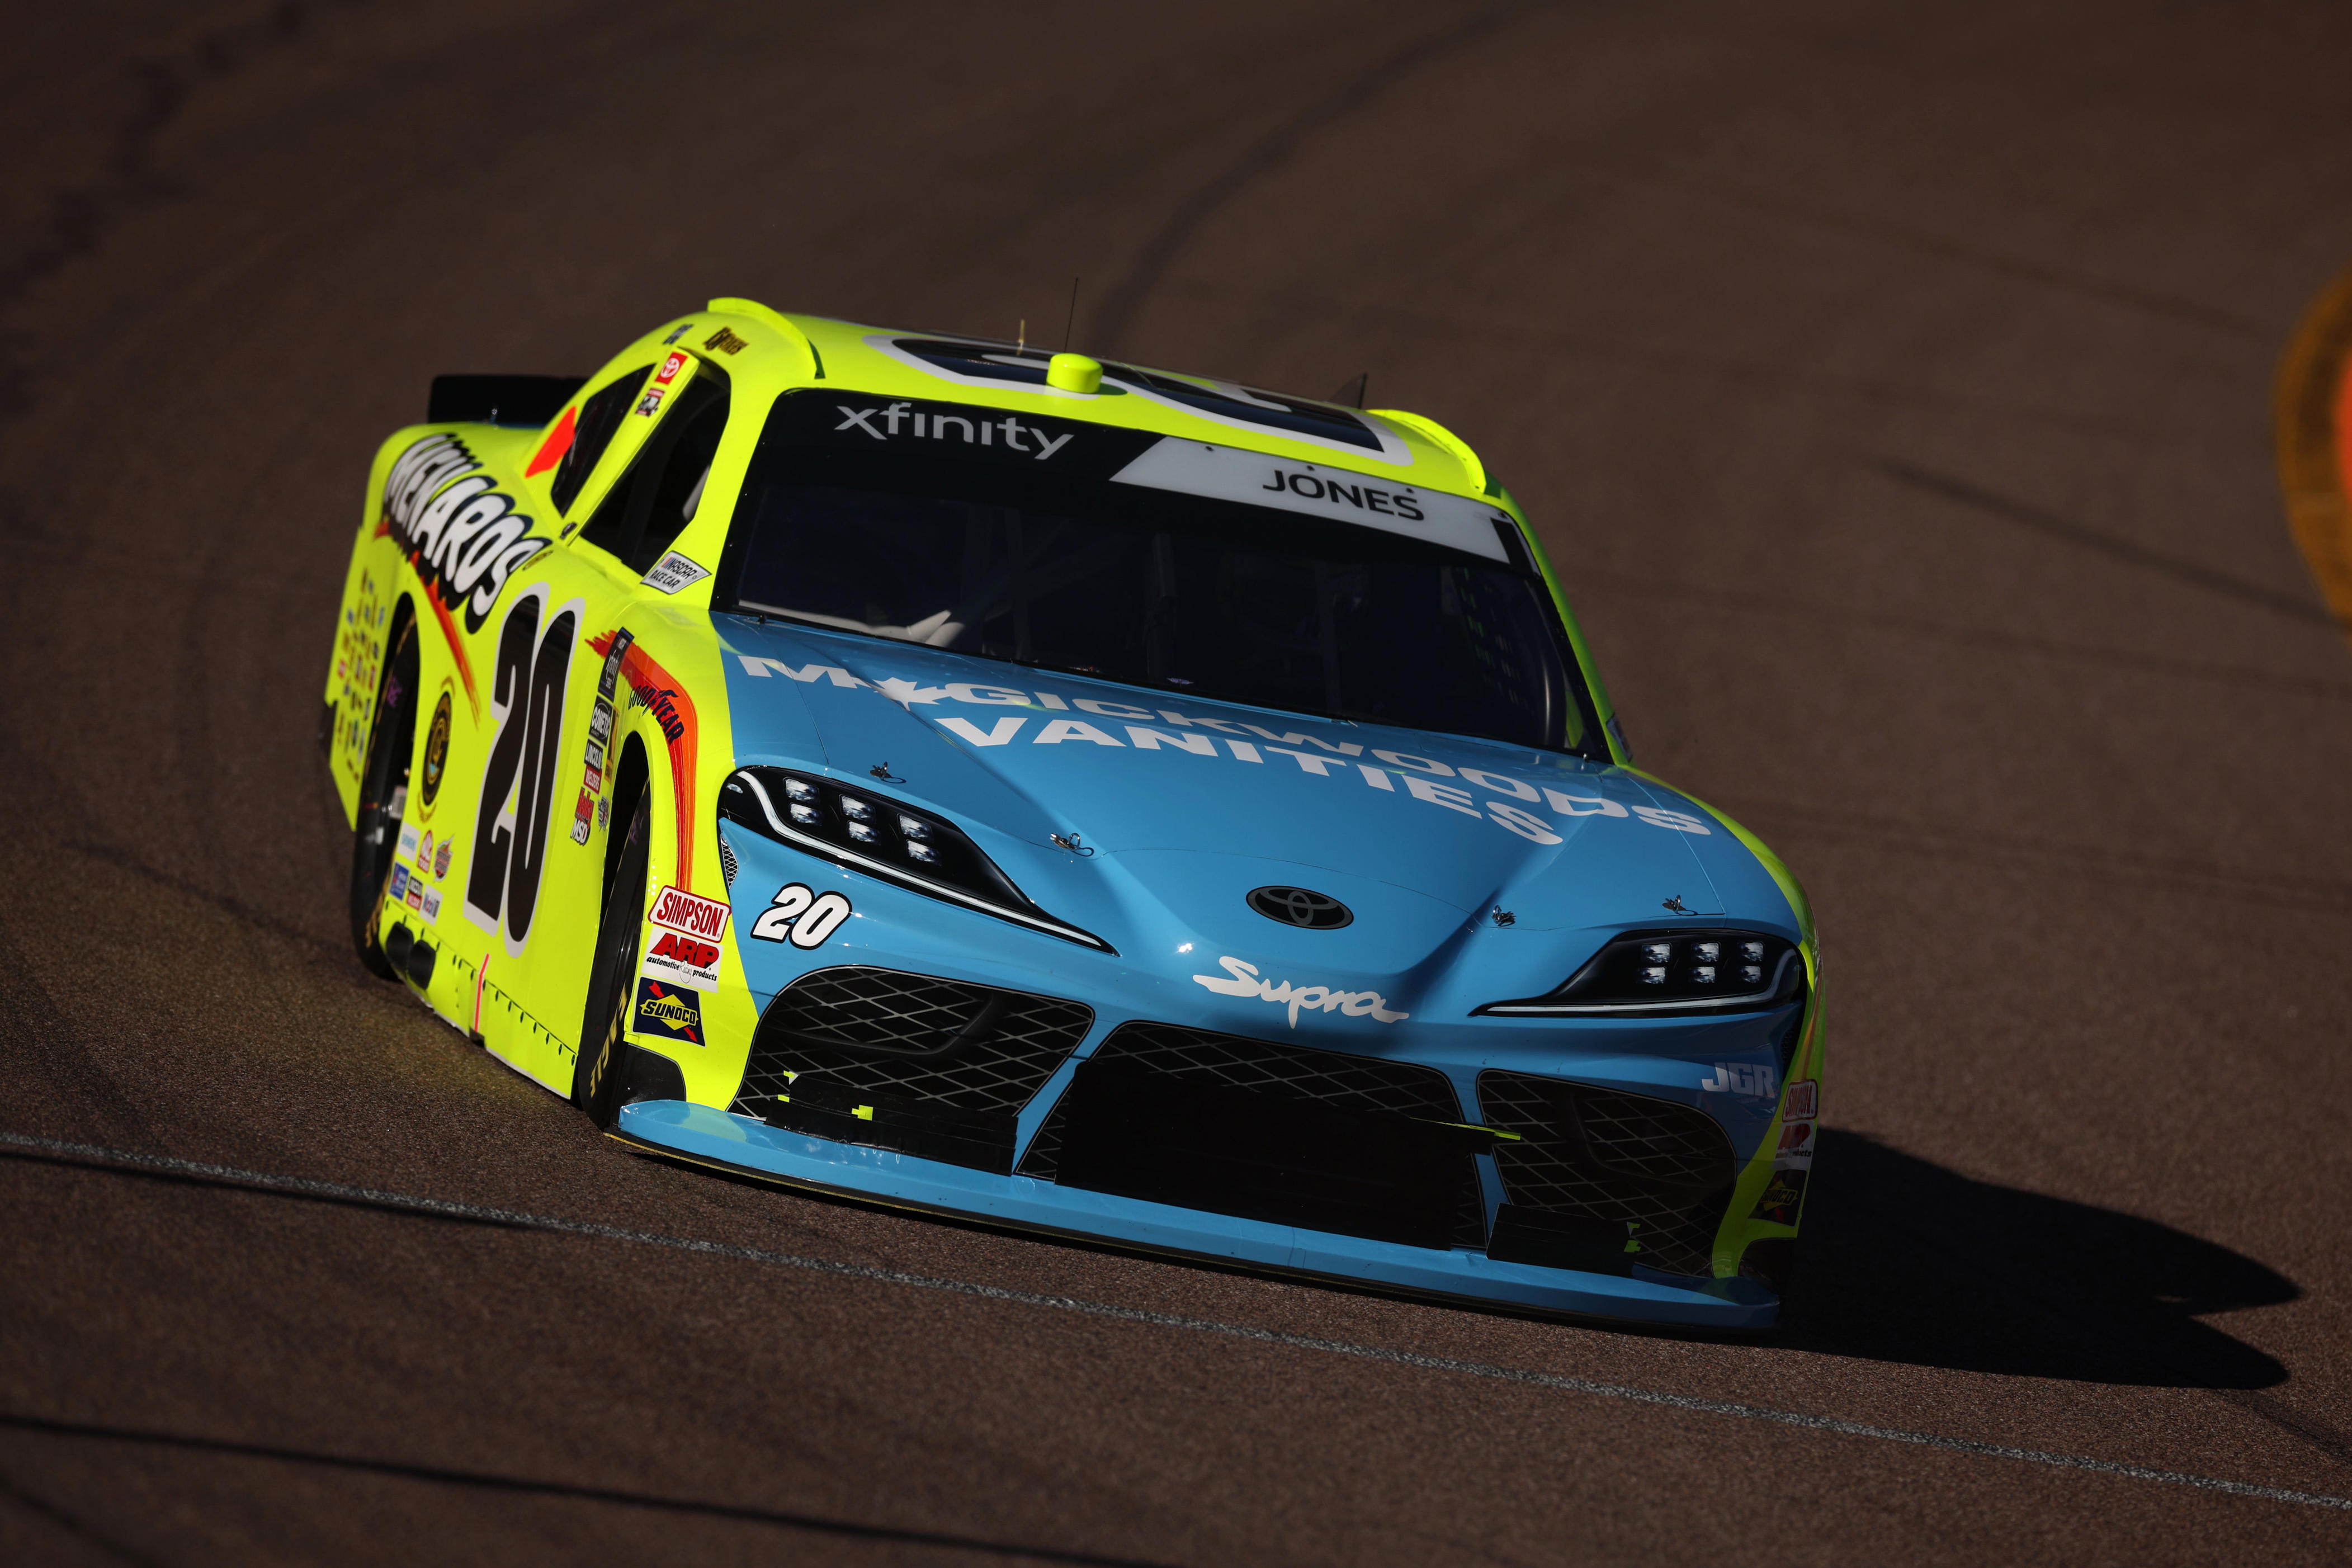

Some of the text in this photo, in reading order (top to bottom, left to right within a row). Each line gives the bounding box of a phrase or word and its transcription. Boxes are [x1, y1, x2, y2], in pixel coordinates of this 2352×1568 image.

[834, 402, 1075, 461] xfinity
[1263, 469, 1426, 522] JONES
[383, 433, 552, 620] MENARDS
[649, 570, 681, 588] RACE CAR
[665, 558, 697, 579] NASCAR
[591, 706, 611, 738] COMETIC
[628, 685, 684, 745] GOODYEAR
[465, 582, 585, 957] 20
[585, 743, 602, 769] LINCOLN
[585, 769, 600, 791] WELDERS
[934, 717, 1563, 845] VANITIES
[570, 818, 589, 845] MSD
[657, 892, 724, 937] SIMPSON
[751, 882, 852, 950] 20
[646, 956, 680, 971] automotive
[692, 968, 717, 981] products
[650, 932, 720, 969] ARP
[1192, 956, 1410, 1029] Supra
[643, 1000, 697, 1024] SUNOCO
[1702, 1062, 1775, 1098] JGR
